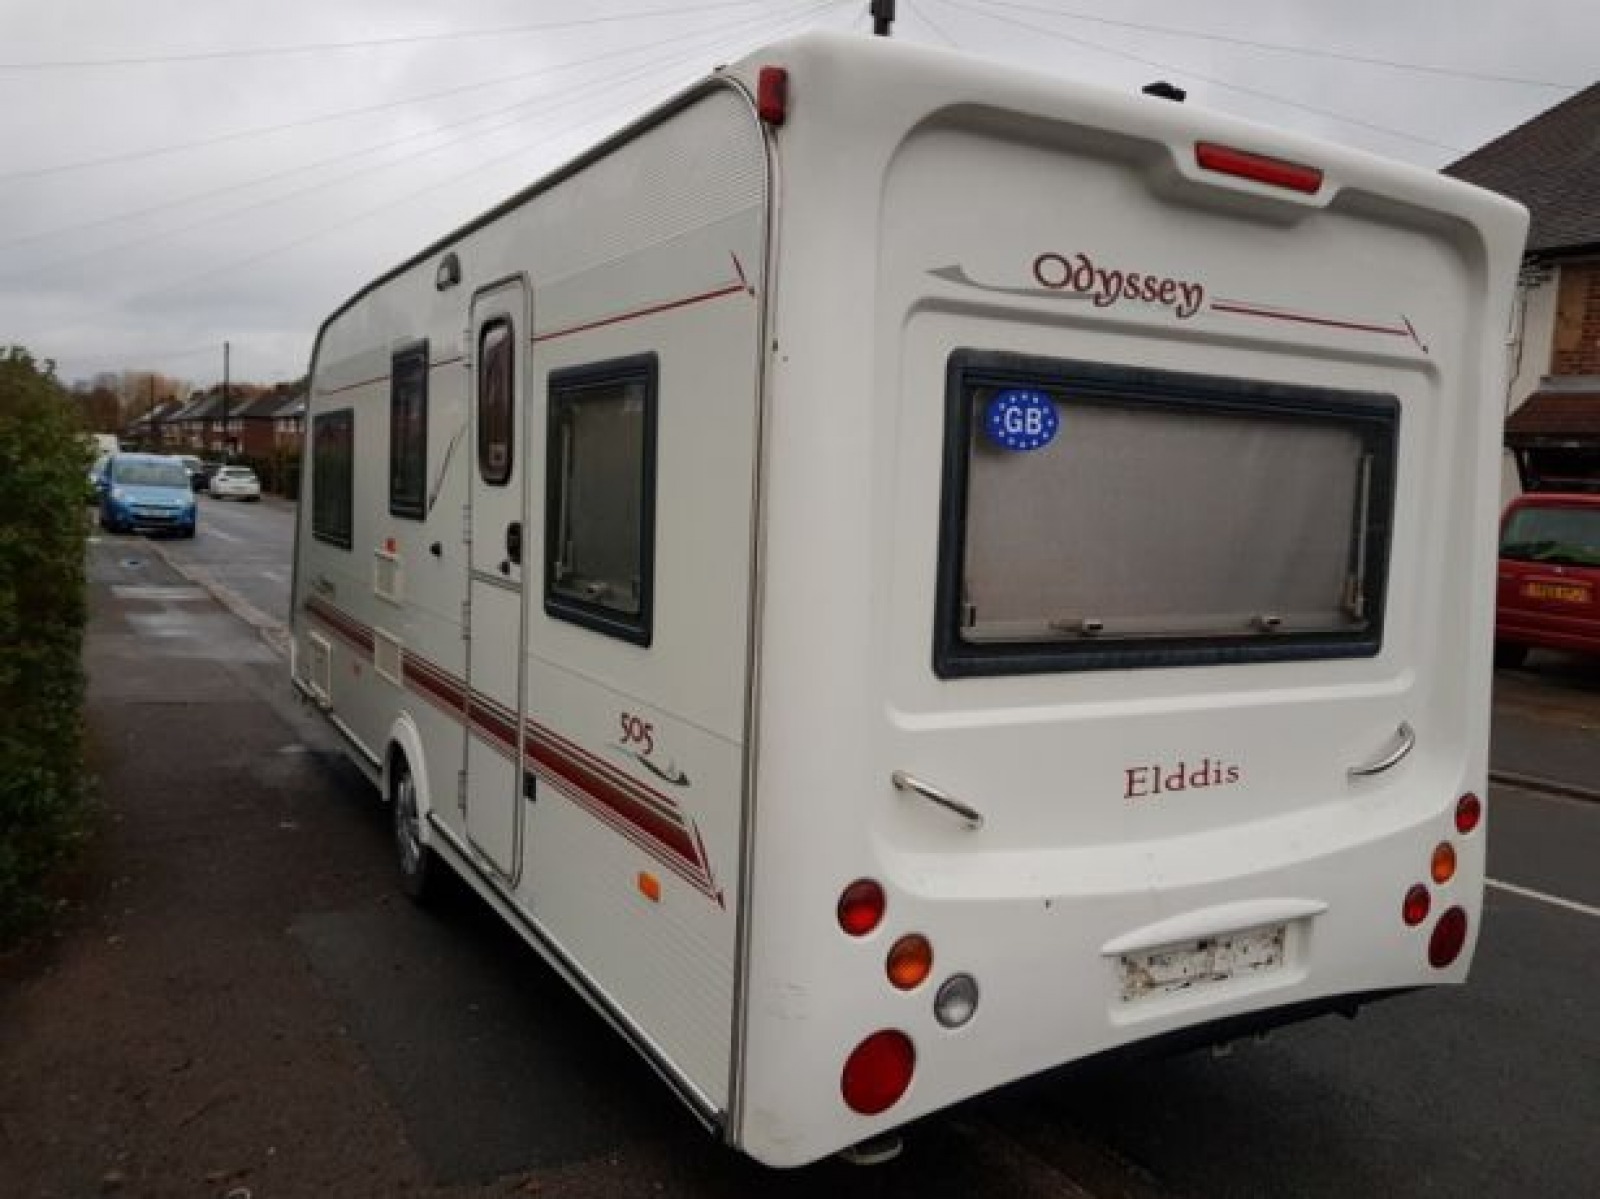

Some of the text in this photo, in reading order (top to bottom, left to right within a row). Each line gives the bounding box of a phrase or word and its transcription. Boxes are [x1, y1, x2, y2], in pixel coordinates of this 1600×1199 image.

[1033, 253, 1203, 317] Odyssey
[1003, 406, 1042, 435] GB
[621, 712, 653, 754] 505
[1123, 758, 1240, 798] Elddis
